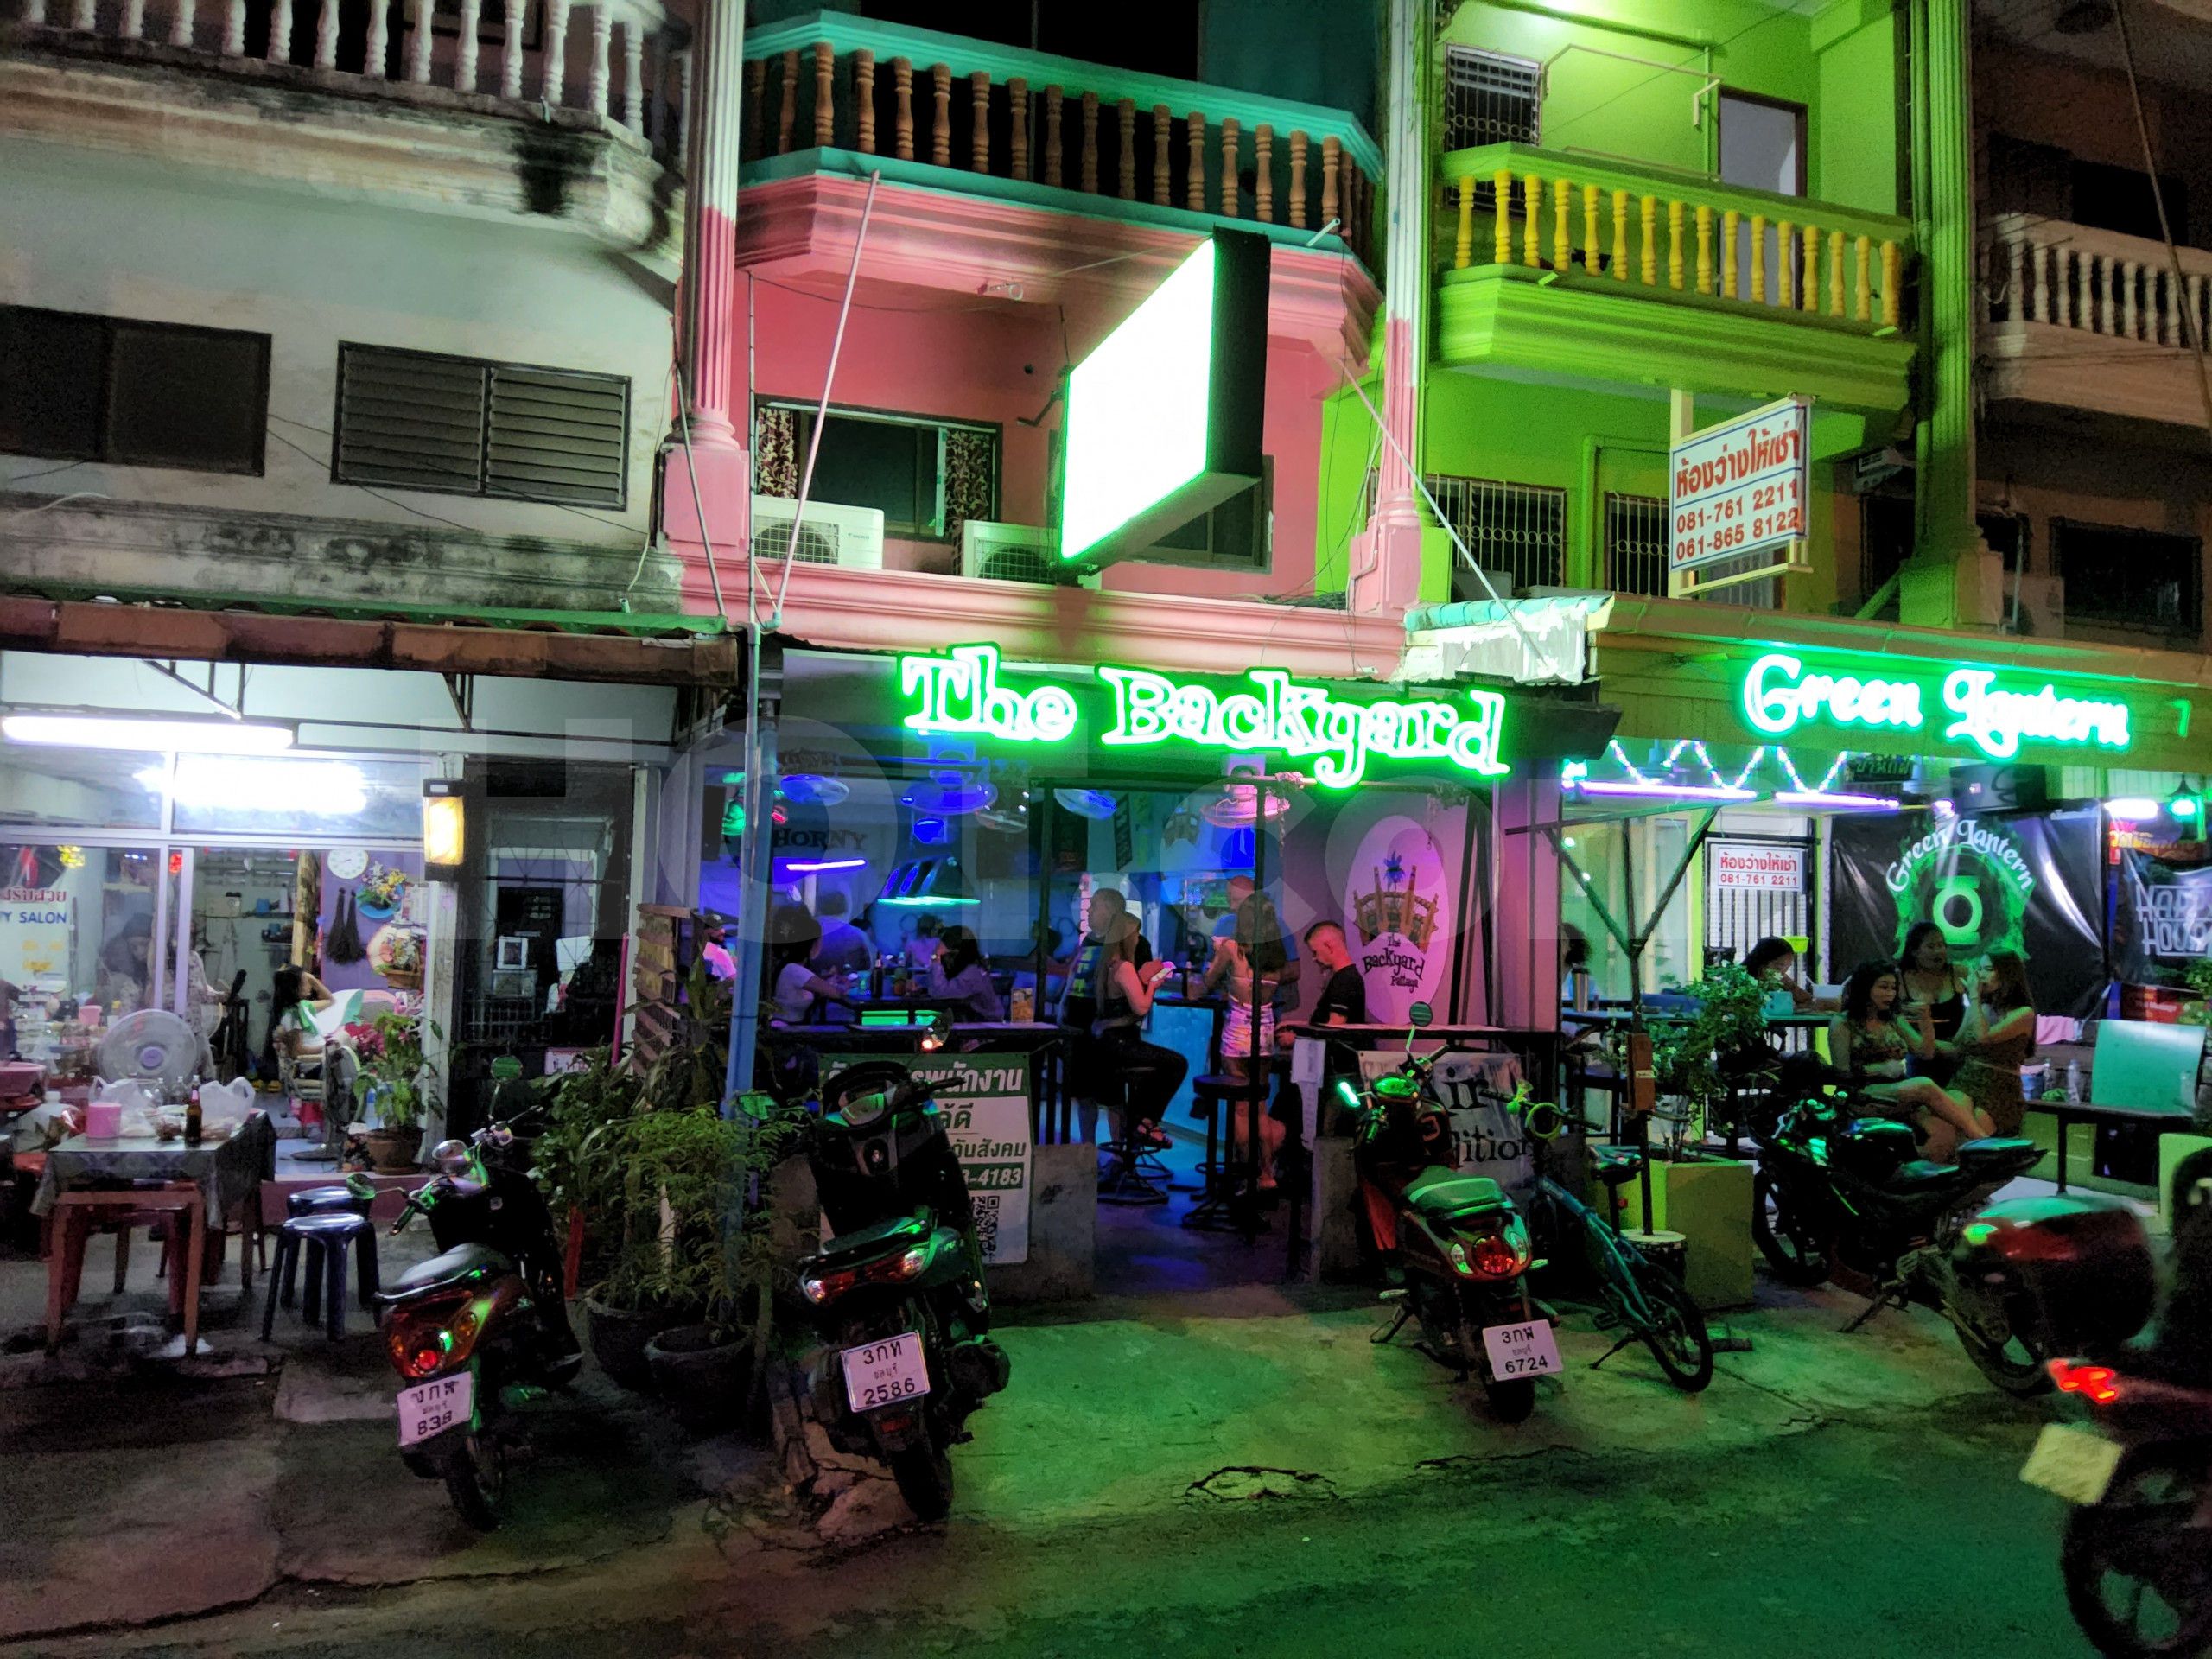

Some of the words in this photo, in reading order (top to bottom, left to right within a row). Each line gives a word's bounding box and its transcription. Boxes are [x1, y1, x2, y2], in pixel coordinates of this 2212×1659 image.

[1676, 420, 1800, 499] ห้องว่างให้เช่า
[1676, 495, 1744, 534] 081-761
[1753, 478, 1798, 511] 2211
[1676, 523, 1744, 561] 061-865
[1752, 506, 1799, 539] 8122
[901, 645, 1078, 743] The
[1099, 669, 1510, 789] Backyard
[1743, 654, 1923, 735] Green
[1942, 668, 2131, 761] Lantern
[1720, 852, 1797, 872] ห้องว่างให้เช่า
[1886, 827, 1951, 892] Green
[1956, 820, 2033, 890] Lantern
[1720, 874, 1765, 884] 081-761
[1771, 875, 1797, 886] 2211
[19, 911, 67, 924] SALON
[1363, 948, 1426, 980] Backyard
[1504, 1355, 1548, 1374] 6724
[863, 1378, 915, 1405] 2586
[417, 1411, 452, 1435] 838
